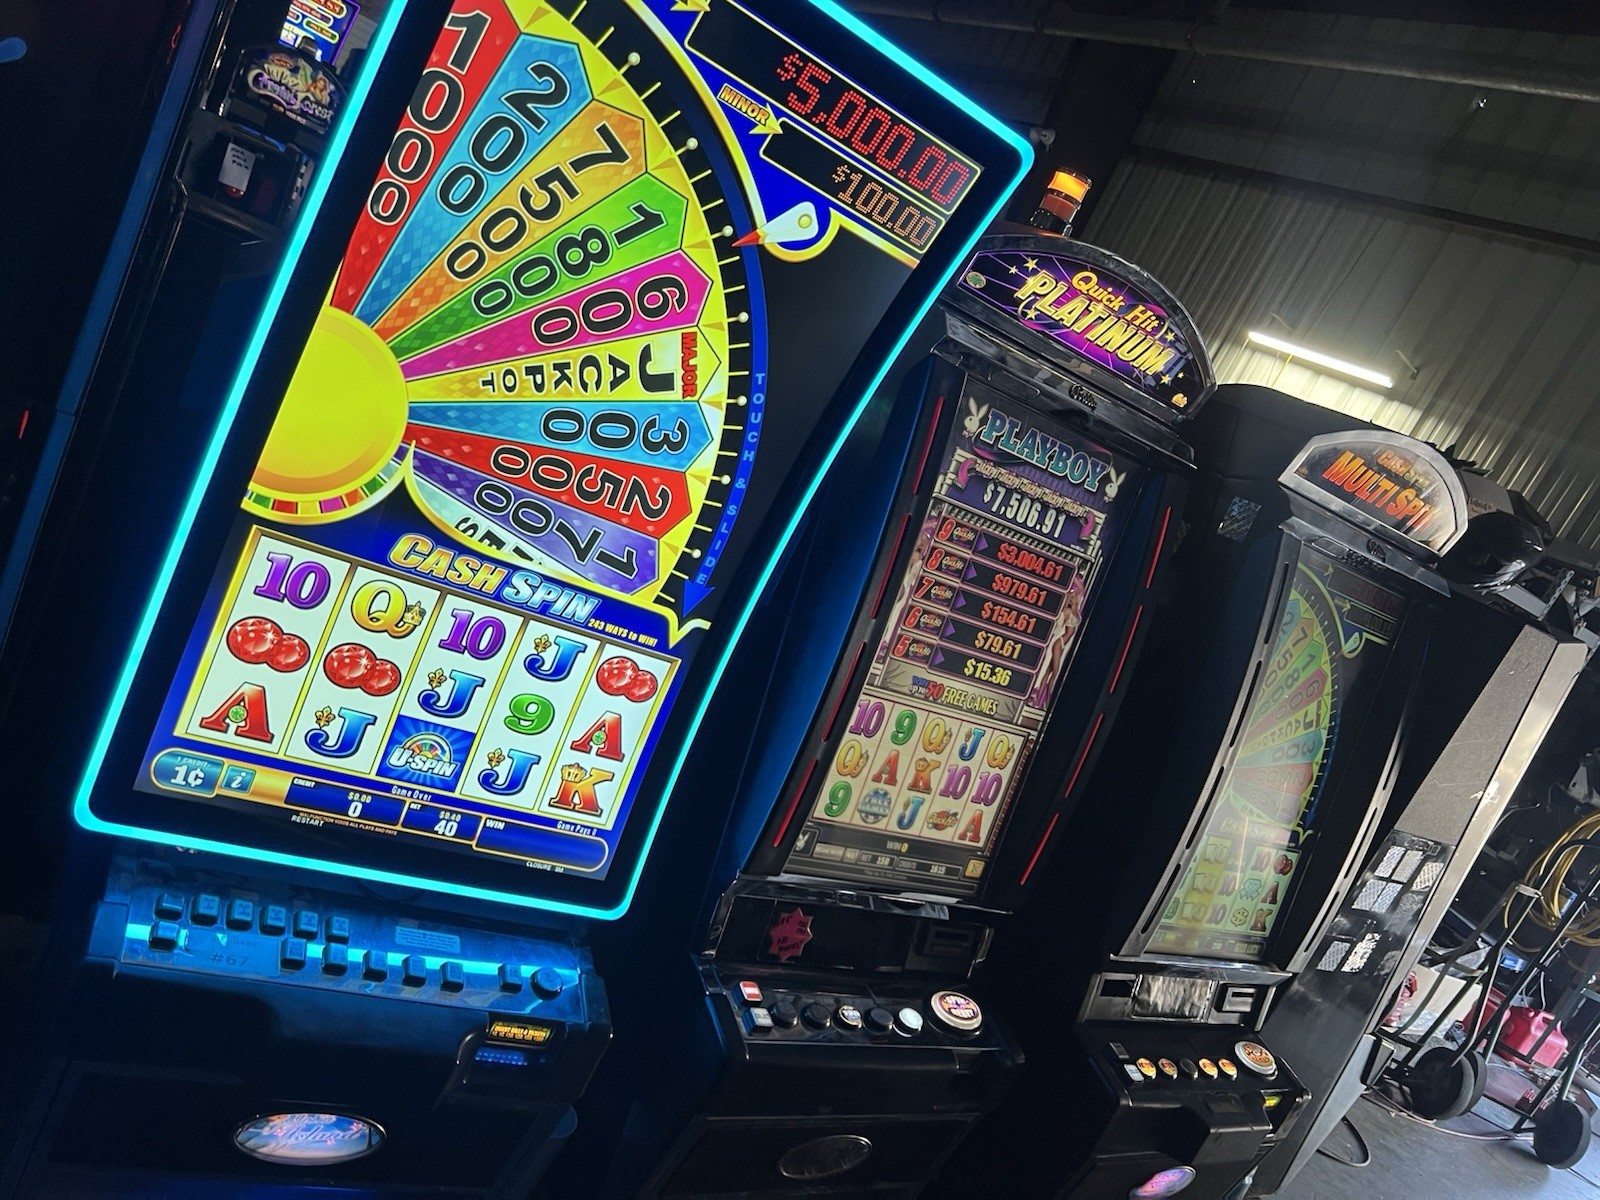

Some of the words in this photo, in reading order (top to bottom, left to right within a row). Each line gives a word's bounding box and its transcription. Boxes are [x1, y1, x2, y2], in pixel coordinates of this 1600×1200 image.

[366, 9, 491, 227] 1000
[720, 85, 772, 126] MINOR
[437, 61, 571, 216] 200
[776, 53, 970, 206] $5,000.00
[446, 121, 632, 281] 7500
[832, 165, 937, 247] $100.00
[471, 201, 668, 318] 1800
[531, 275, 689, 346] 600
[1071, 270, 1127, 313] Quick
[1123, 304, 1161, 334] Hit
[1013, 269, 1177, 376] PLATINUM
[480, 340, 678, 395] JACKPOT
[681, 332, 698, 400] MAJOR
[540, 408, 690, 455] 300
[743, 373, 766, 462] TOUCH
[980, 408, 1110, 493] PLAYBOY
[1377, 450, 1412, 477] CASH
[491, 445, 672, 522] 2500
[1322, 450, 1400, 509] MULTI
[983, 481, 1067, 539] $7,506.91
[473, 481, 638, 581] 1700
[696, 504, 738, 585] SLIDE
[938, 519, 956, 541] 9
[253, 552, 331, 610] 10
[389, 533, 510, 595] CASH
[502, 568, 603, 625] SPIN
[997, 543, 1064, 581] $3,004.61
[915, 577, 935, 599] 7
[992, 573, 1047, 607] $979.61
[351, 579, 420, 640] Q
[981, 601, 1037, 634] $154.61
[439, 608, 506, 660] 10
[605, 623, 628, 638] WAYS
[628, 631, 637, 640] to
[894, 634, 913, 657] 5
[975, 630, 1022, 660] $79.61
[523, 634, 588, 682] J
[964, 658, 1012, 687] $15.36
[199, 681, 274, 745] A
[417, 669, 485, 719] J
[941, 686, 967, 707] FREE
[966, 693, 999, 716] GAMES
[304, 706, 378, 759] J
[504, 692, 556, 736] 9
[849, 700, 886, 739] 10
[890, 709, 918, 746] 9
[570, 710, 626, 763] A
[922, 717, 949, 755] Q
[958, 727, 986, 762] J
[987, 734, 1012, 770] Q
[170, 764, 205, 788] 1¢
[477, 748, 542, 797] J
[836, 739, 864, 779] Q
[872, 749, 900, 787] A
[907, 757, 942, 795] K
[347, 791, 372, 804] $0.00
[391, 785, 412, 798] Game
[412, 789, 432, 801] Over
[548, 764, 616, 817] K
[824, 780, 853, 818] 9
[939, 764, 972, 800] 10
[970, 771, 1003, 807] 10
[291, 815, 325, 827] RESTART
[347, 801, 363, 818] 0
[434, 819, 459, 837] 40
[439, 811, 462, 821] $0.40
[485, 819, 506, 830] WIN
[557, 820, 575, 832] Game
[896, 796, 926, 831] J
[957, 808, 984, 843] A
[1261, 881, 1280, 906] A
